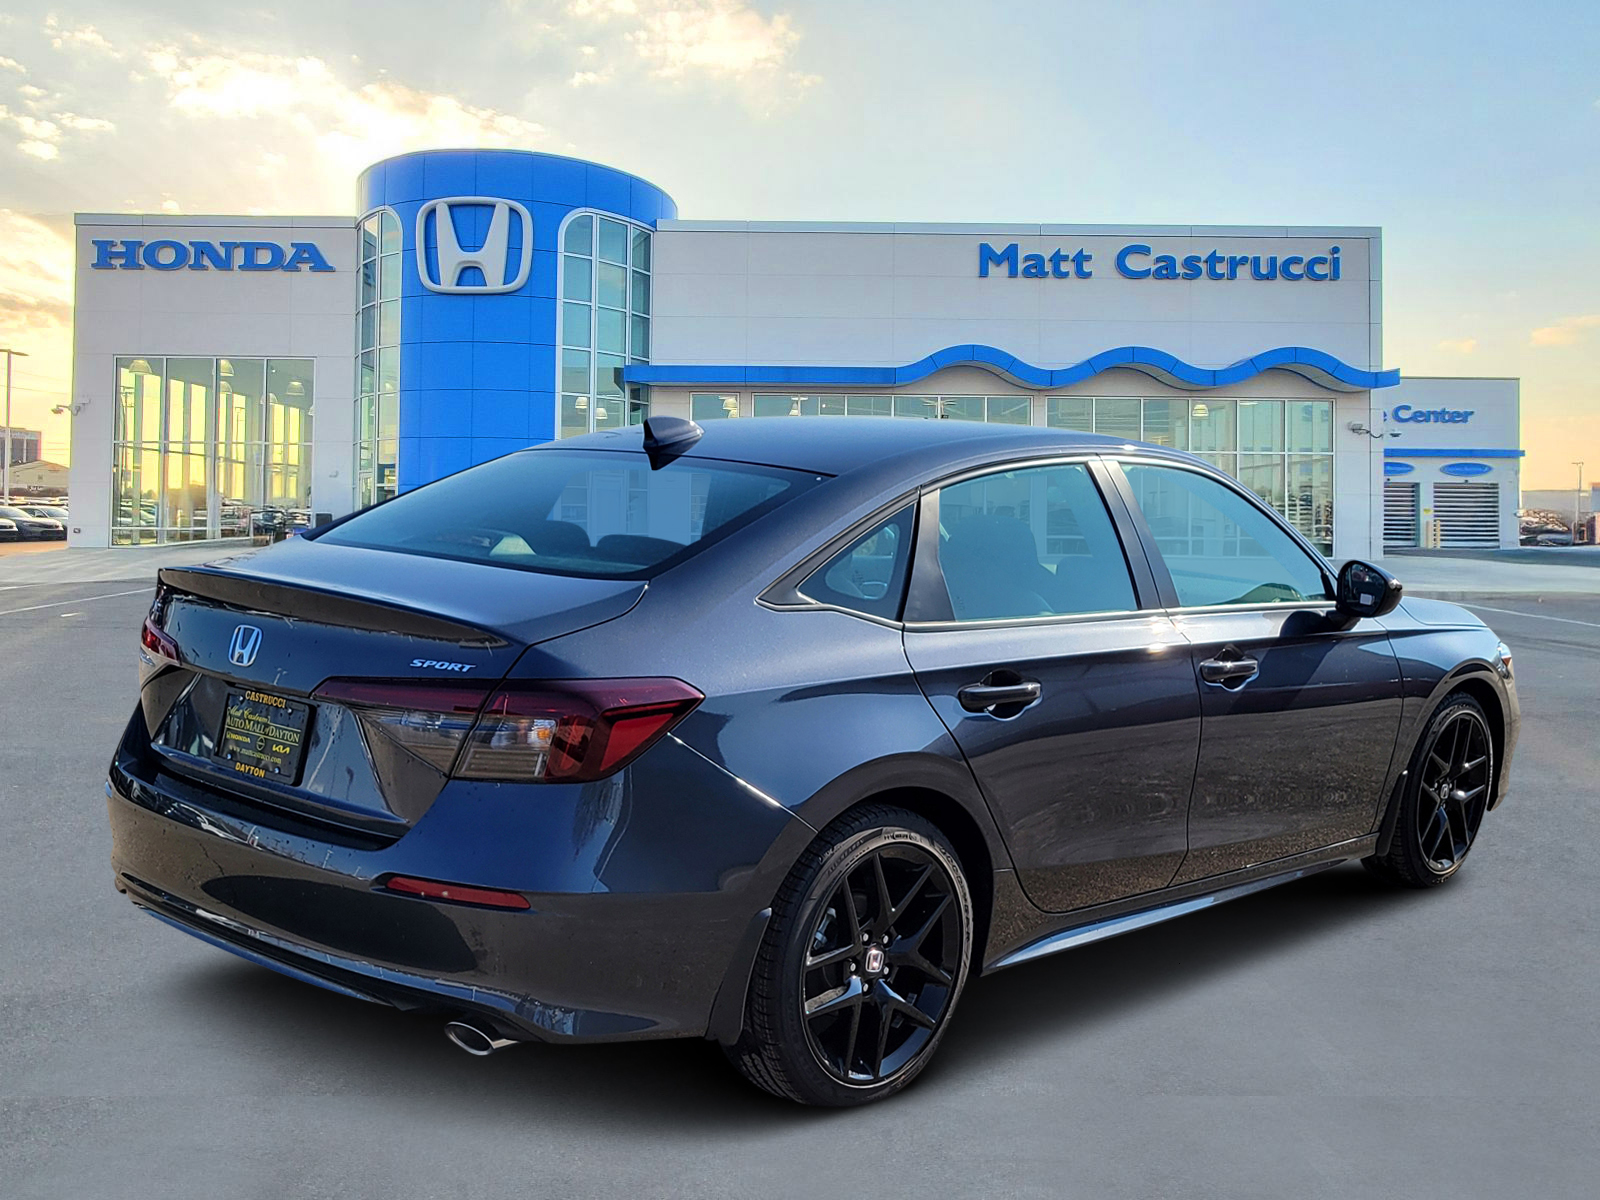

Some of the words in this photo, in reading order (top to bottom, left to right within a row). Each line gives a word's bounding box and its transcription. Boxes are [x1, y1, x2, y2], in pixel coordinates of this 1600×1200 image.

[91, 239, 336, 272] HONDA
[979, 242, 1093, 279] Matt
[1115, 244, 1342, 281] Castrucci
[1392, 404, 1475, 424] Center
[409, 658, 477, 673] SPORT
[245, 690, 287, 708] CASTRUCCI
[244, 720, 265, 734] MALL
[269, 725, 300, 743] DAYTON
[235, 762, 265, 778] DAYTON
